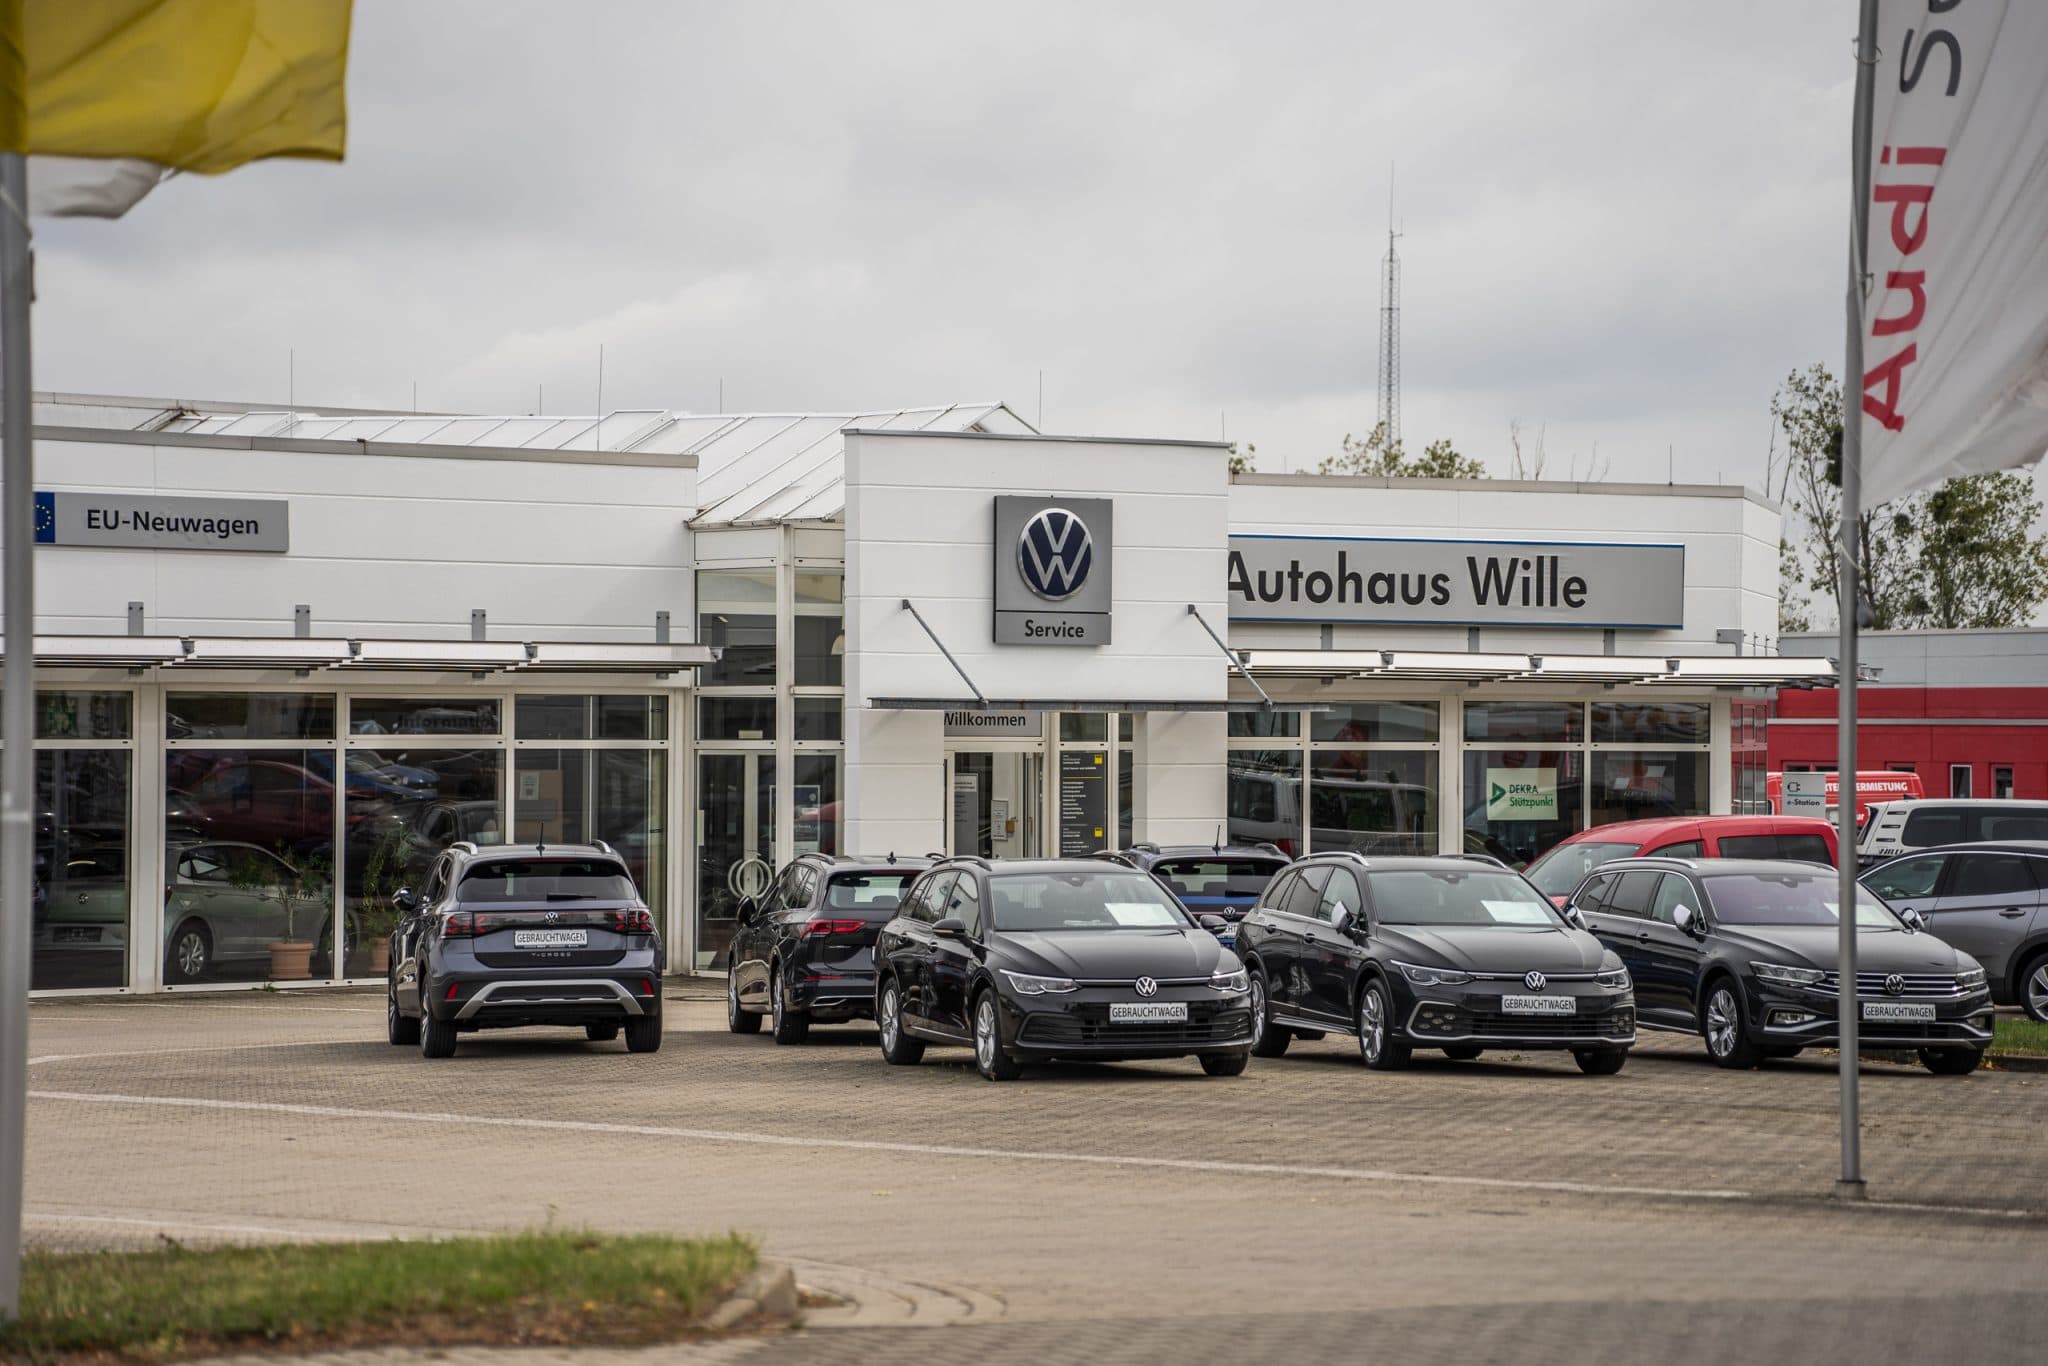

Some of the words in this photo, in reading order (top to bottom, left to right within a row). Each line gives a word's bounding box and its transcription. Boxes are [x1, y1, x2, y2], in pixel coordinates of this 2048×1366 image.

[1862, 145, 1948, 433] Audi
[86, 509, 259, 539] EU-Neuwagen
[1228, 550, 1451, 606] Autohaus
[1466, 555, 1588, 609] Wille
[1024, 619, 1085, 638] Service
[1509, 784, 1539, 794] DEKRA
[1856, 782, 1908, 792] ERMIETUNG
[1510, 796, 1553, 809] Stützpunkt
[516, 932, 585, 943] GEBRAUCHTWAGEN
[1503, 998, 1575, 1010] GEBRAUCHTWAGEN
[1111, 1006, 1186, 1018] GEBRAUCHTWAGEN
[1865, 1005, 1934, 1017] GEBRAUCHTWAGEN
